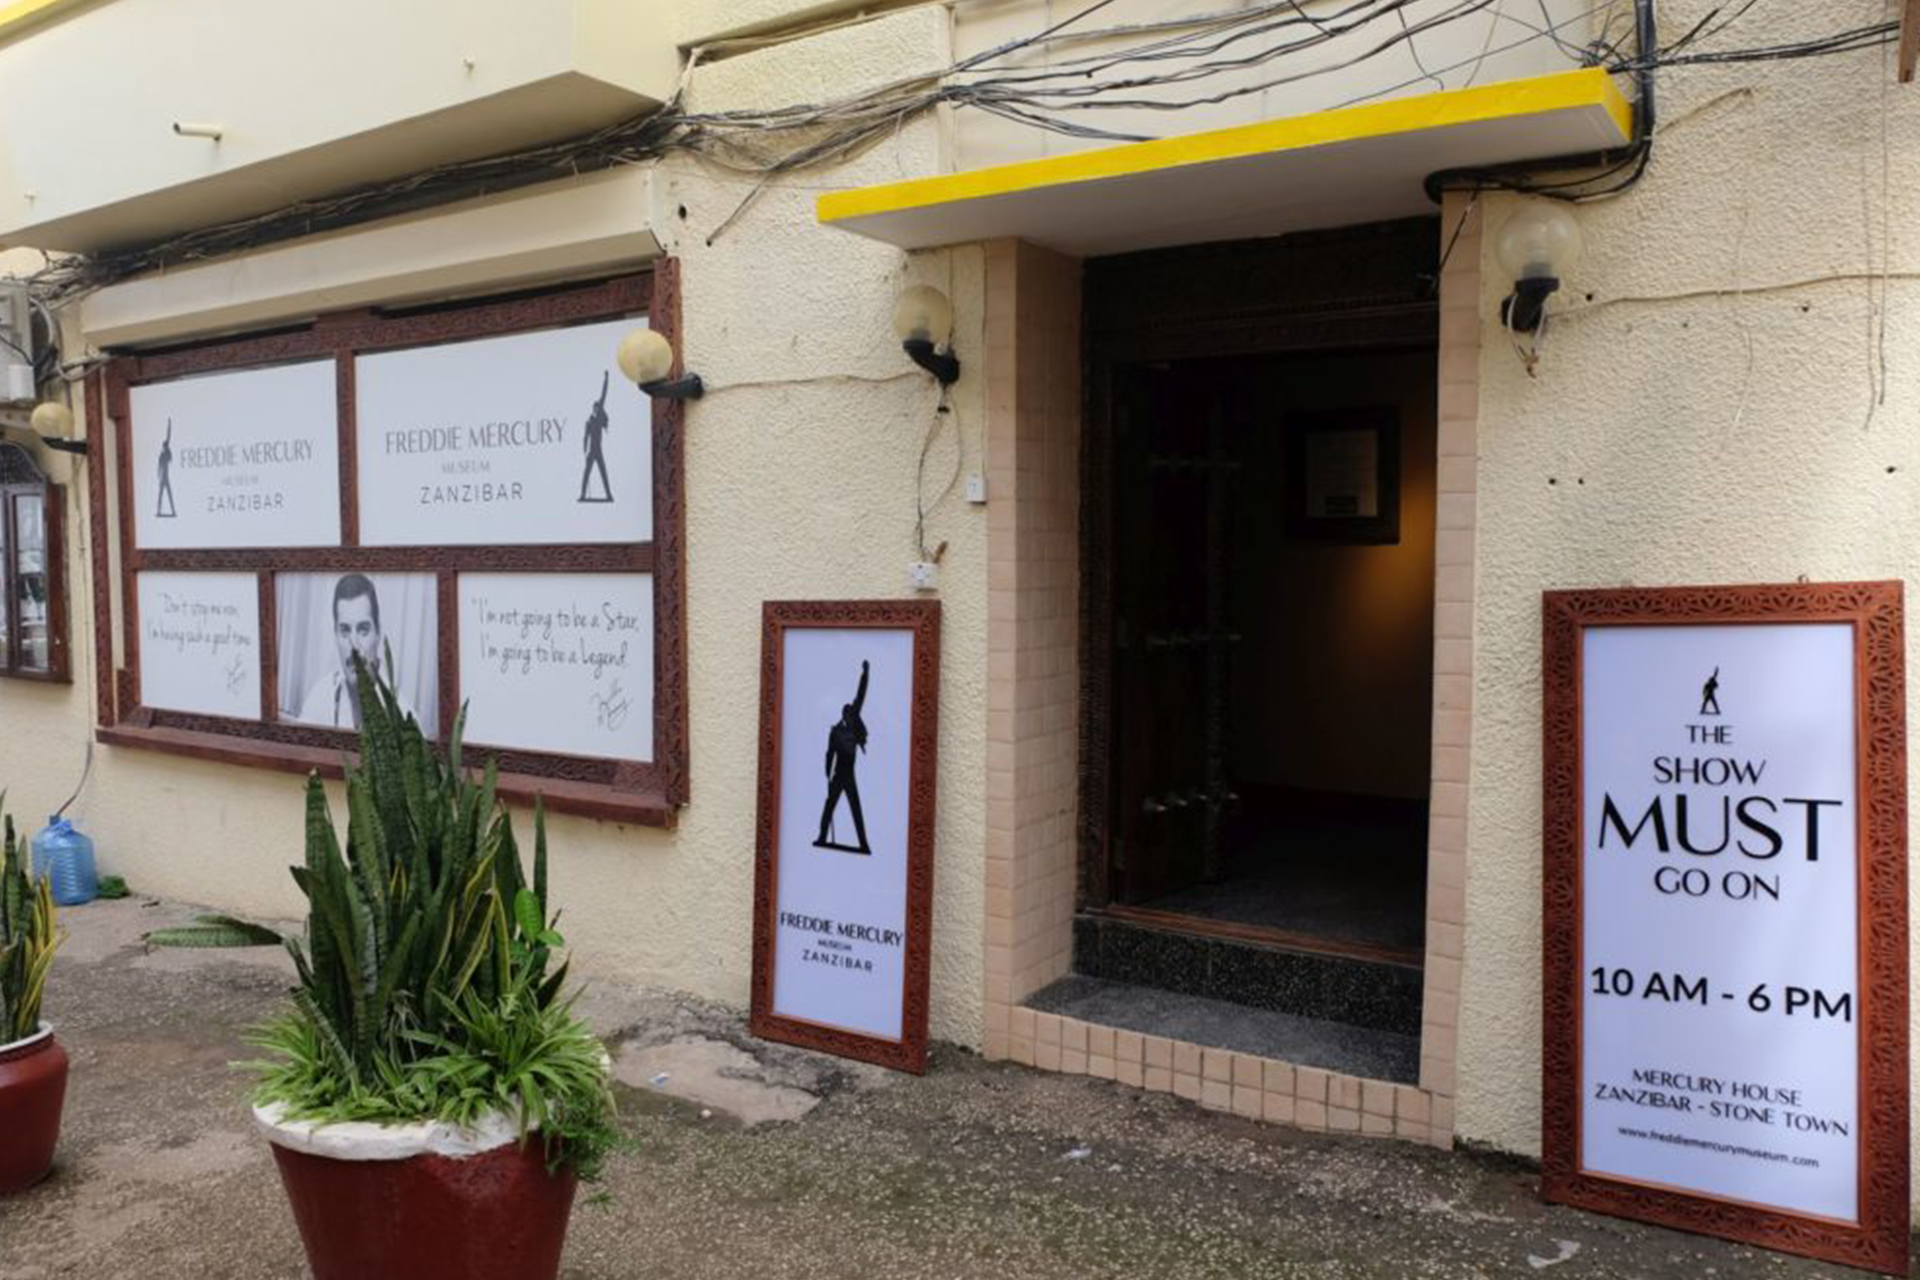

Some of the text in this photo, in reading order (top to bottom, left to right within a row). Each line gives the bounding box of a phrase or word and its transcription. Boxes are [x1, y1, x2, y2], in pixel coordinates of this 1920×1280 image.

[180, 438, 316, 469] FREDDIE MERCURY
[385, 417, 568, 454] FREDDIE MERCURY
[207, 492, 284, 512] ZANZIBAR
[420, 481, 524, 504] ZANZIBAR
[499, 608, 518, 626] not
[520, 609, 552, 640] going
[557, 608, 571, 628] to
[572, 601, 587, 628] be
[590, 613, 600, 629] a
[480, 632, 498, 660] I'm
[500, 645, 531, 675] going
[536, 644, 549, 664] to
[550, 637, 565, 664] be
[568, 650, 578, 664] a
[1684, 724, 1733, 745] THE
[1653, 756, 1767, 786] SHOW
[1598, 791, 1843, 862] MUST
[1654, 865, 1780, 901] GO ON
[780, 911, 903, 947] FREDDIE MERCURY
[802, 948, 873, 972] ZANZIBAR
[1590, 966, 1852, 1023] 10 AM - 6 PM
[1632, 1068, 1803, 1108] MERCURY HOUSE
[1594, 1082, 1692, 1113] ZANZIBAR
[1710, 1101, 1775, 1125] STONE
[1781, 1110, 1849, 1137] TOWN
[1618, 1124, 1820, 1168] www.freddiemercurymuseum.com
